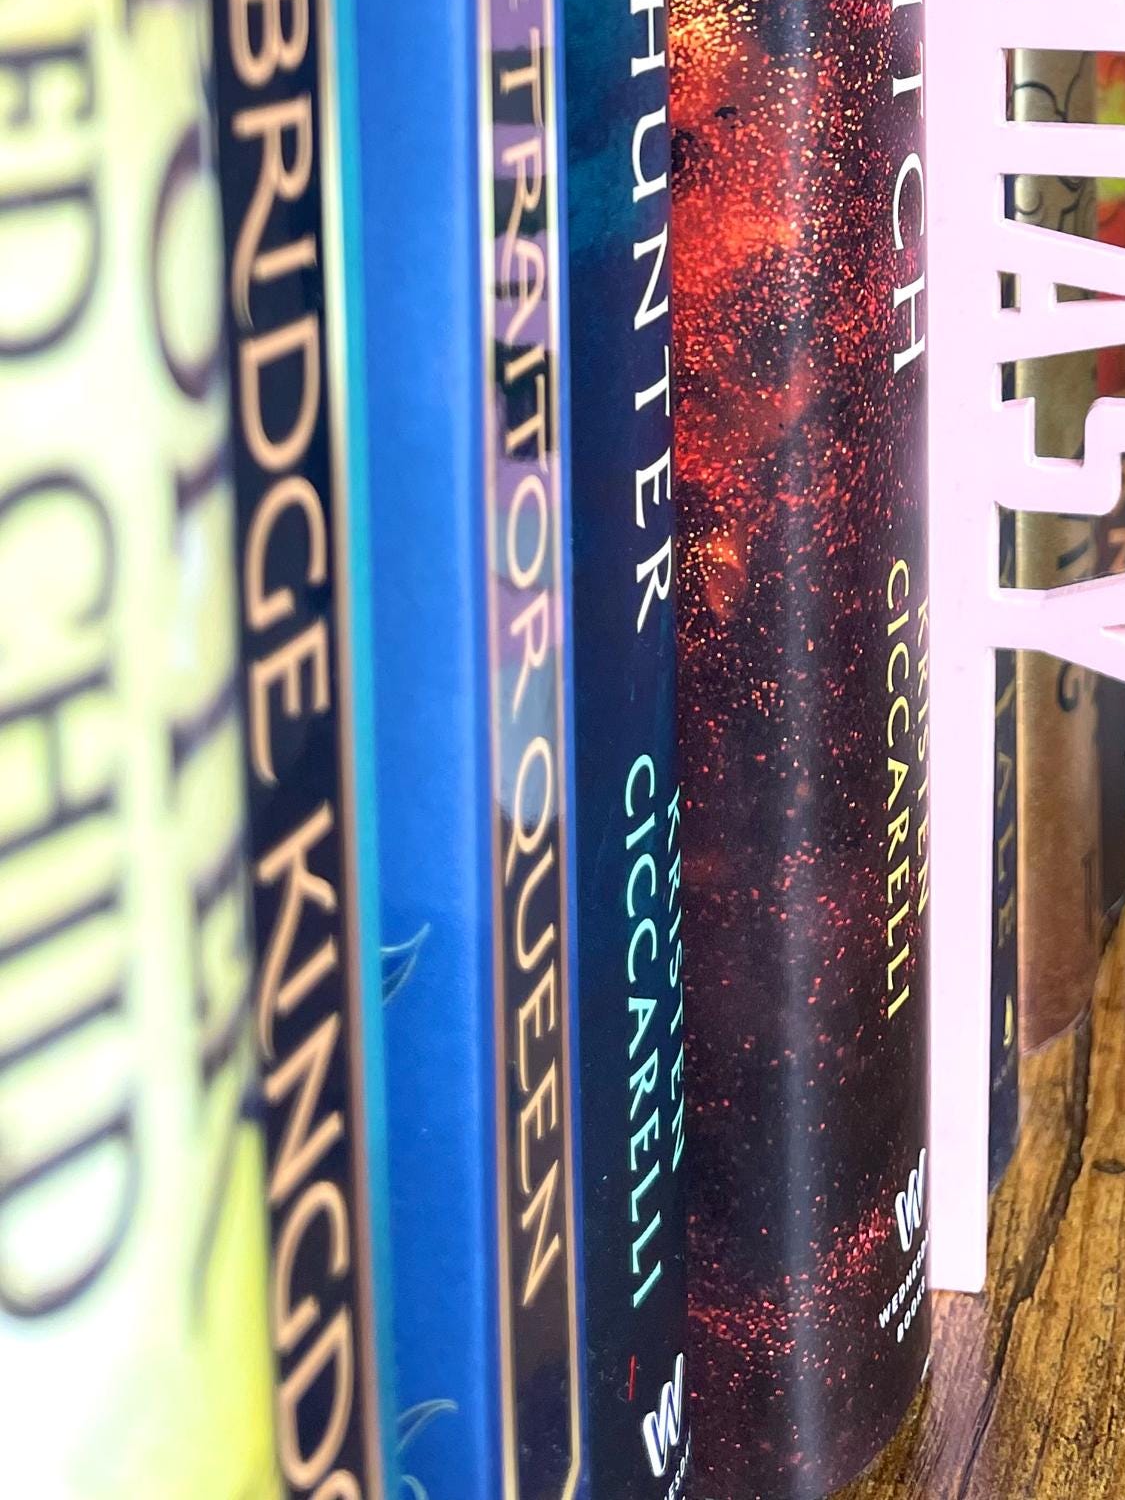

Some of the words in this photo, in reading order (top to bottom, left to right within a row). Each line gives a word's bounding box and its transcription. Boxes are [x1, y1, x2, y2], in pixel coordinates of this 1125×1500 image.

[500, 28, 557, 720] TRAITOR
[505, 736, 562, 1306] QUEEN
[625, 753, 662, 1308] CICCARELLI
[666, 785, 686, 1172] KRISTEN
[887, 558, 912, 1019] CICCARELLI
[910, 595, 929, 918] KRISTEN
[258, 800, 362, 1500] KINGD
